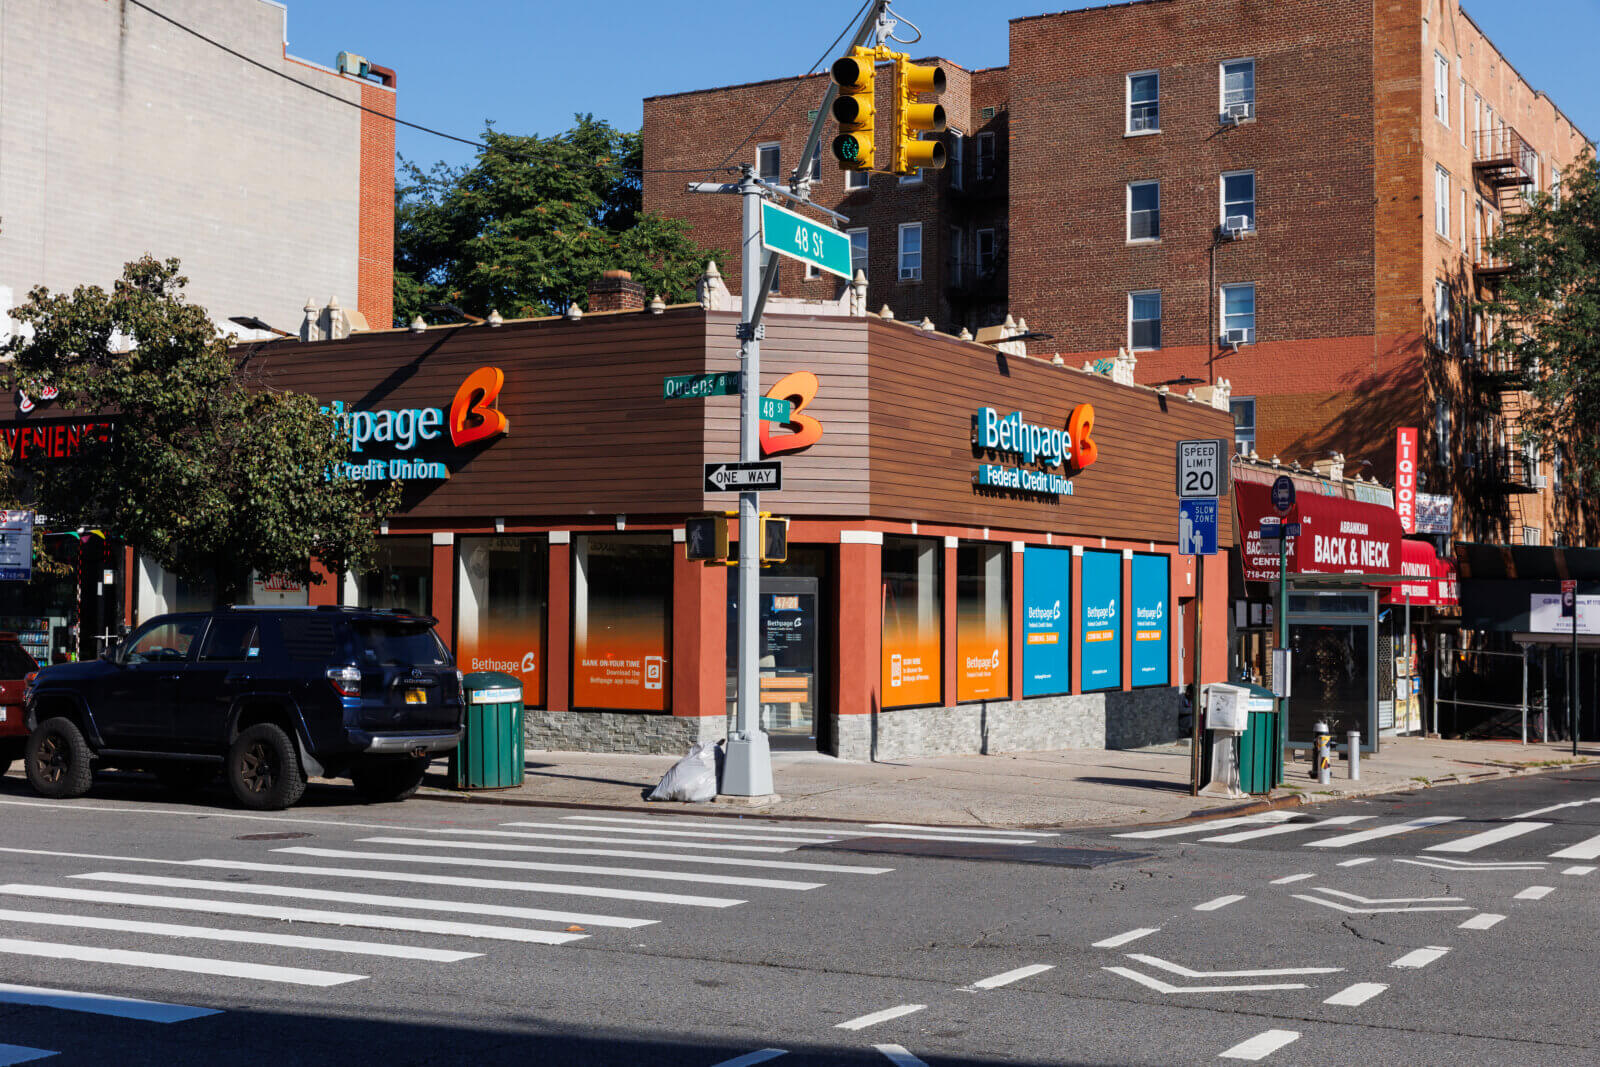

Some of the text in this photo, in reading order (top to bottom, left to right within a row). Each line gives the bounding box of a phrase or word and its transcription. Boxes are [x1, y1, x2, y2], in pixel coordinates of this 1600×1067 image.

[794, 225, 824, 259] 48 St
[666, 375, 738, 396] Queens Blvd
[763, 401, 783, 418] 48 St
[981, 407, 1072, 466] Bethpage
[1184, 447, 1215, 457] SPEED
[389, 458, 443, 479] Union
[1187, 459, 1213, 468] LIMIT
[716, 471, 772, 484] ONE WAY
[983, 464, 1074, 496] Federal Credit Union
[1185, 471, 1214, 491] 20
[1398, 432, 1412, 532] LIQUORS
[1195, 506, 1215, 514] SLOW
[1194, 514, 1215, 523] ZONE
[1314, 534, 1390, 568] BACK & NECK
[1029, 605, 1053, 621] Bethpage
[472, 657, 519, 673] Bethpage
[626, 660, 640, 668] TIME
[967, 656, 991, 670] Bethpage
